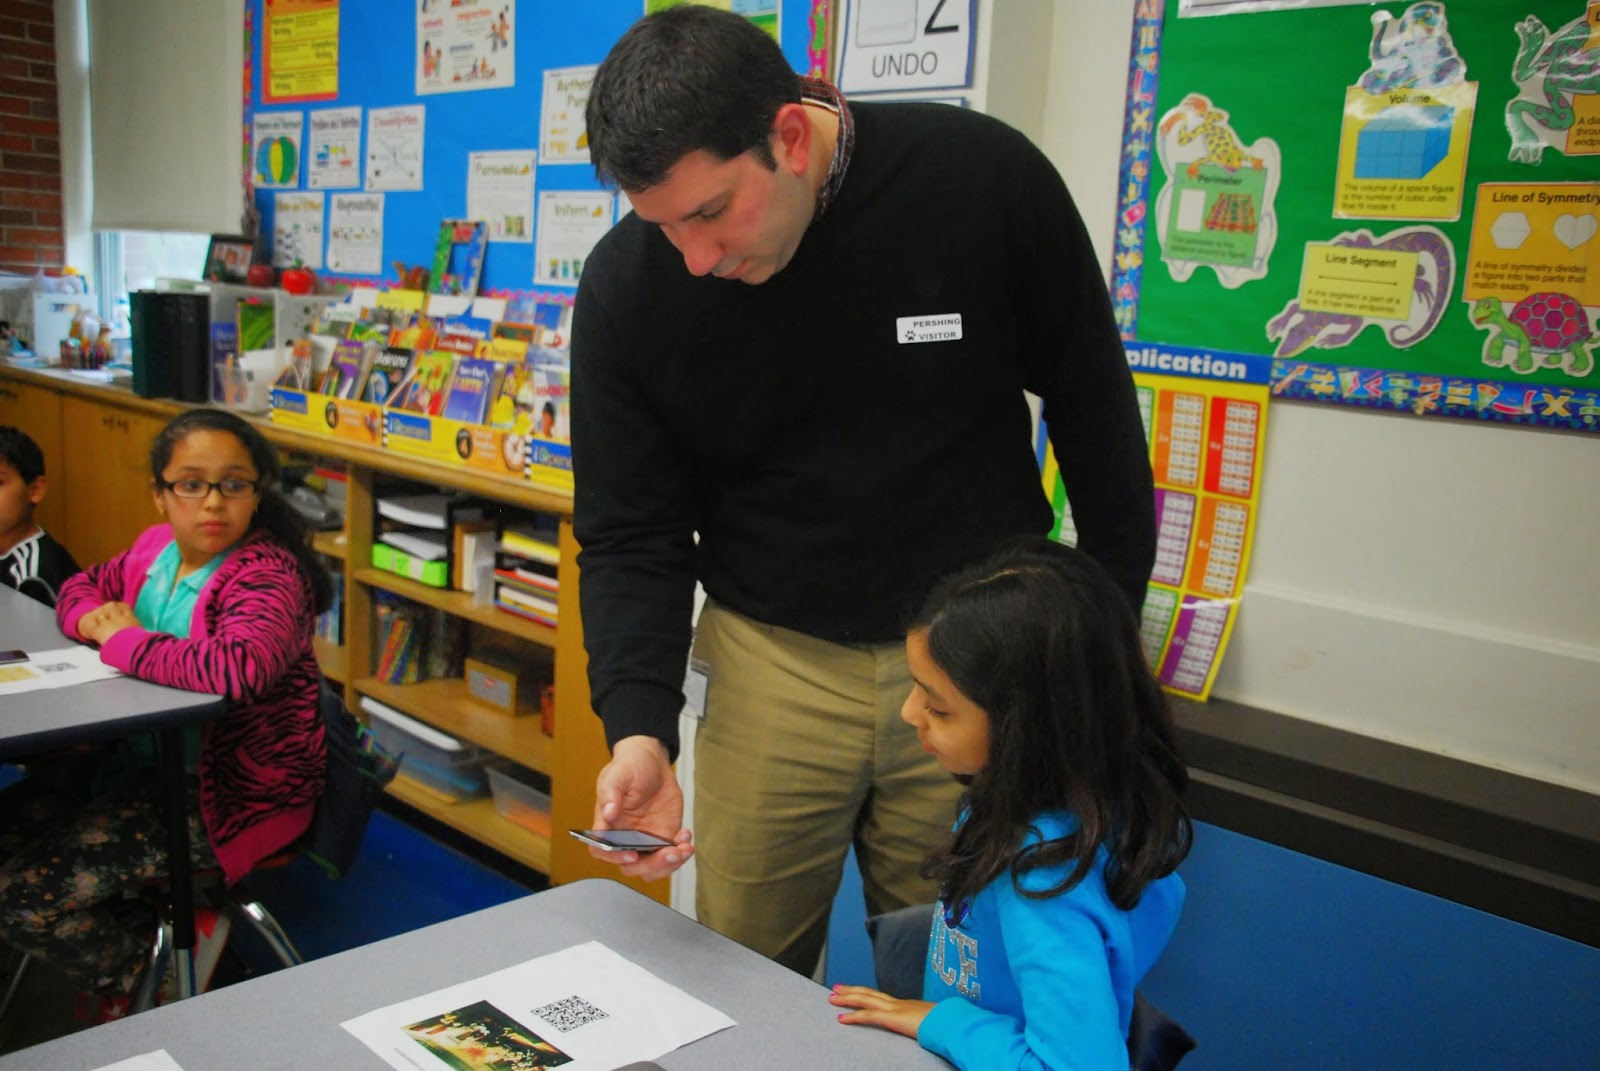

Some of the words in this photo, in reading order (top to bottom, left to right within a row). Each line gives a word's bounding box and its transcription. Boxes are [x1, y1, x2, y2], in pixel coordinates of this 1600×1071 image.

[872, 51, 938, 78] UNDO
[1492, 192, 1518, 203] Line
[1522, 192, 1535, 203] of
[1537, 192, 1600, 206] Symmetry
[1325, 253, 1347, 264] Line
[1350, 255, 1397, 269] Segment
[913, 318, 961, 328] PERSHING
[919, 331, 956, 340] VISITOR
